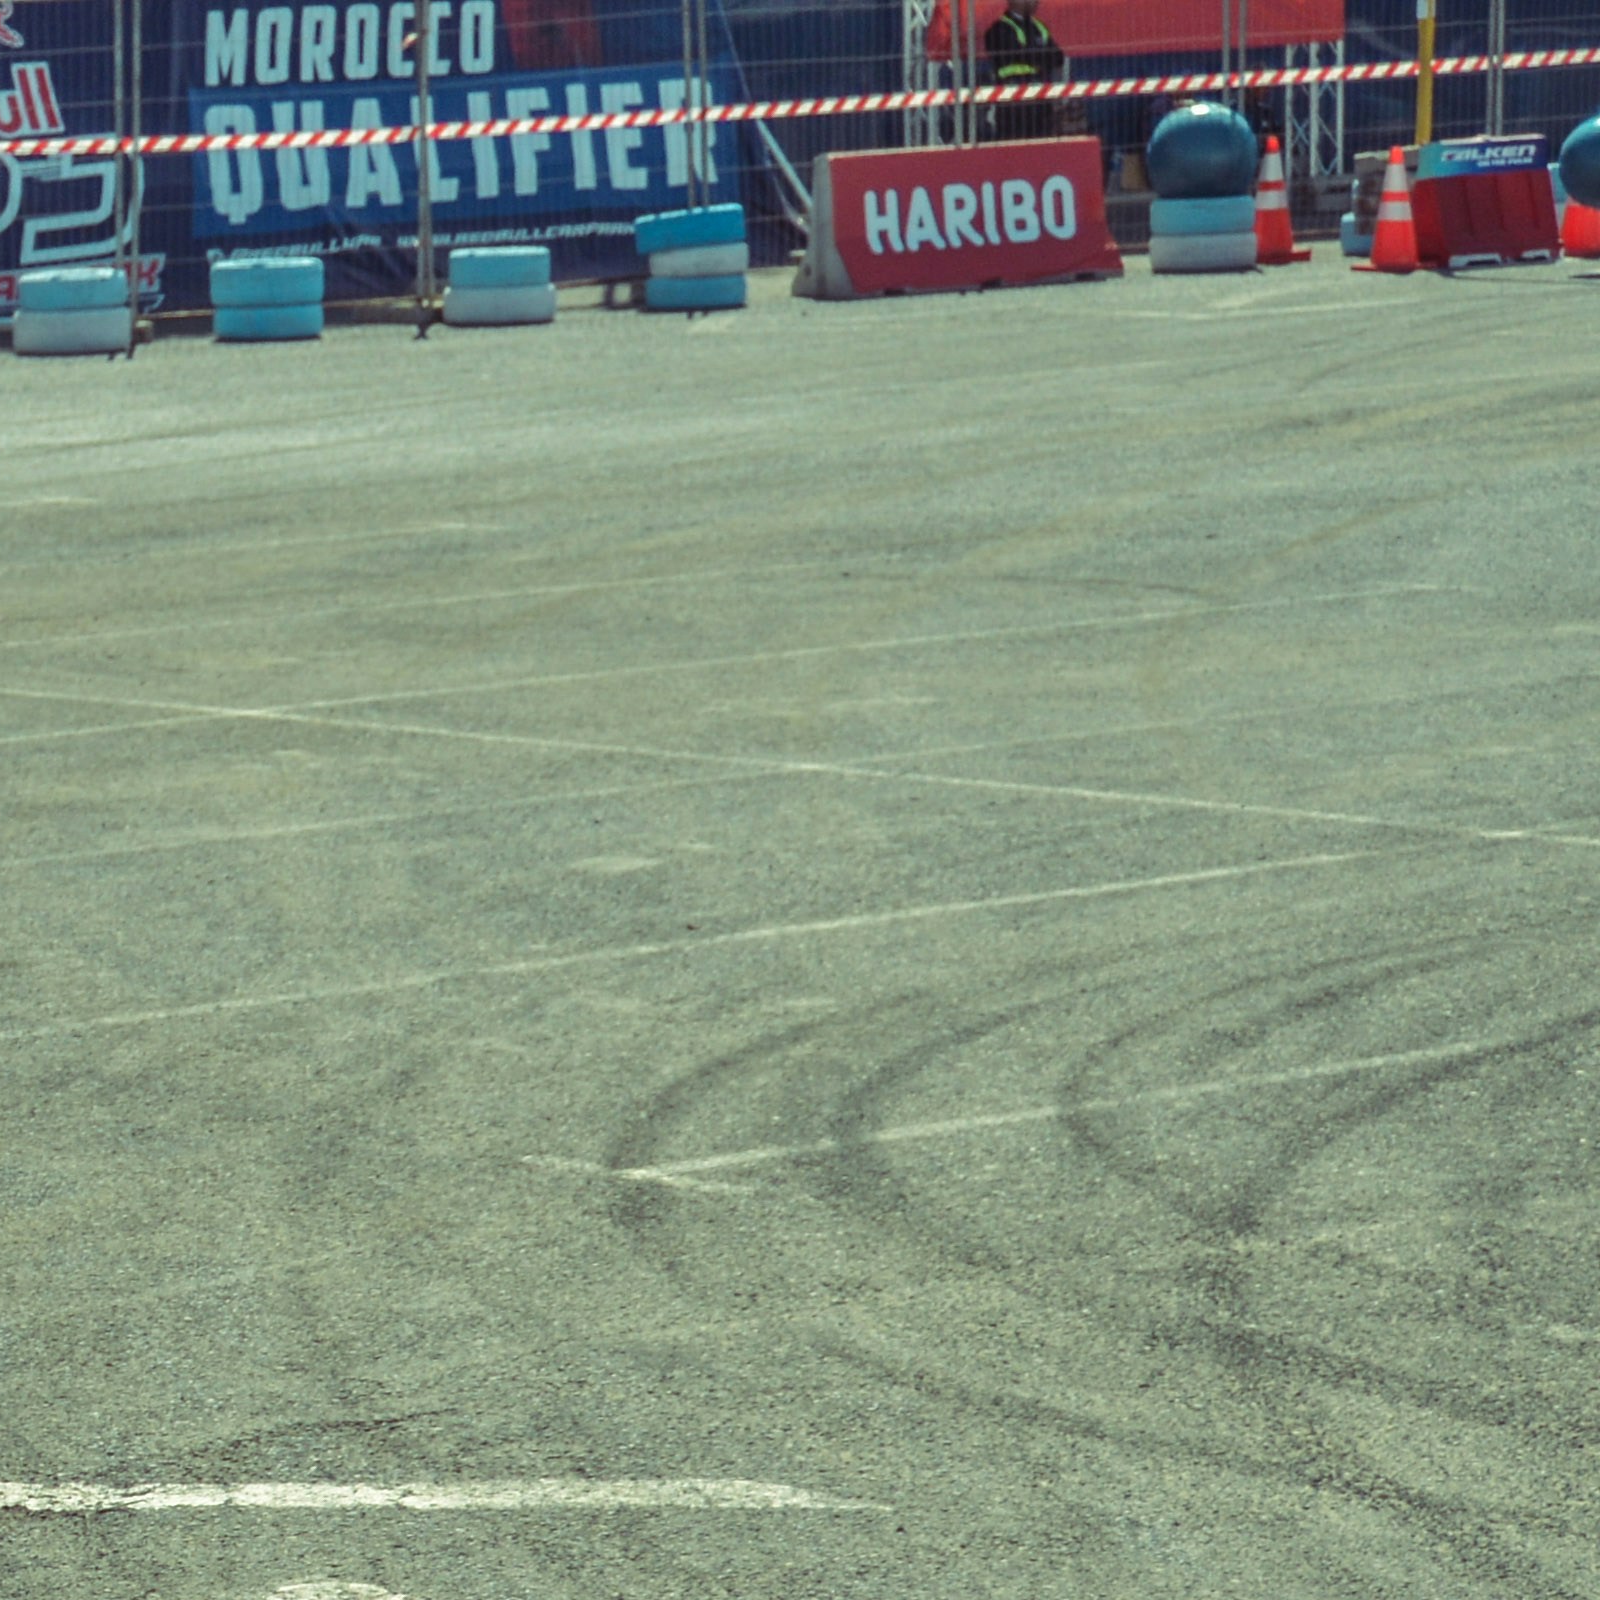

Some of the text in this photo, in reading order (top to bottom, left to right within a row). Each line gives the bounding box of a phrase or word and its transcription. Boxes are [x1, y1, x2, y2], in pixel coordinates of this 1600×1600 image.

[204, 0, 495, 87] MOROCCO
[203, 78, 719, 225] QUALIFIER
[863, 174, 1078, 255] HARIBO
